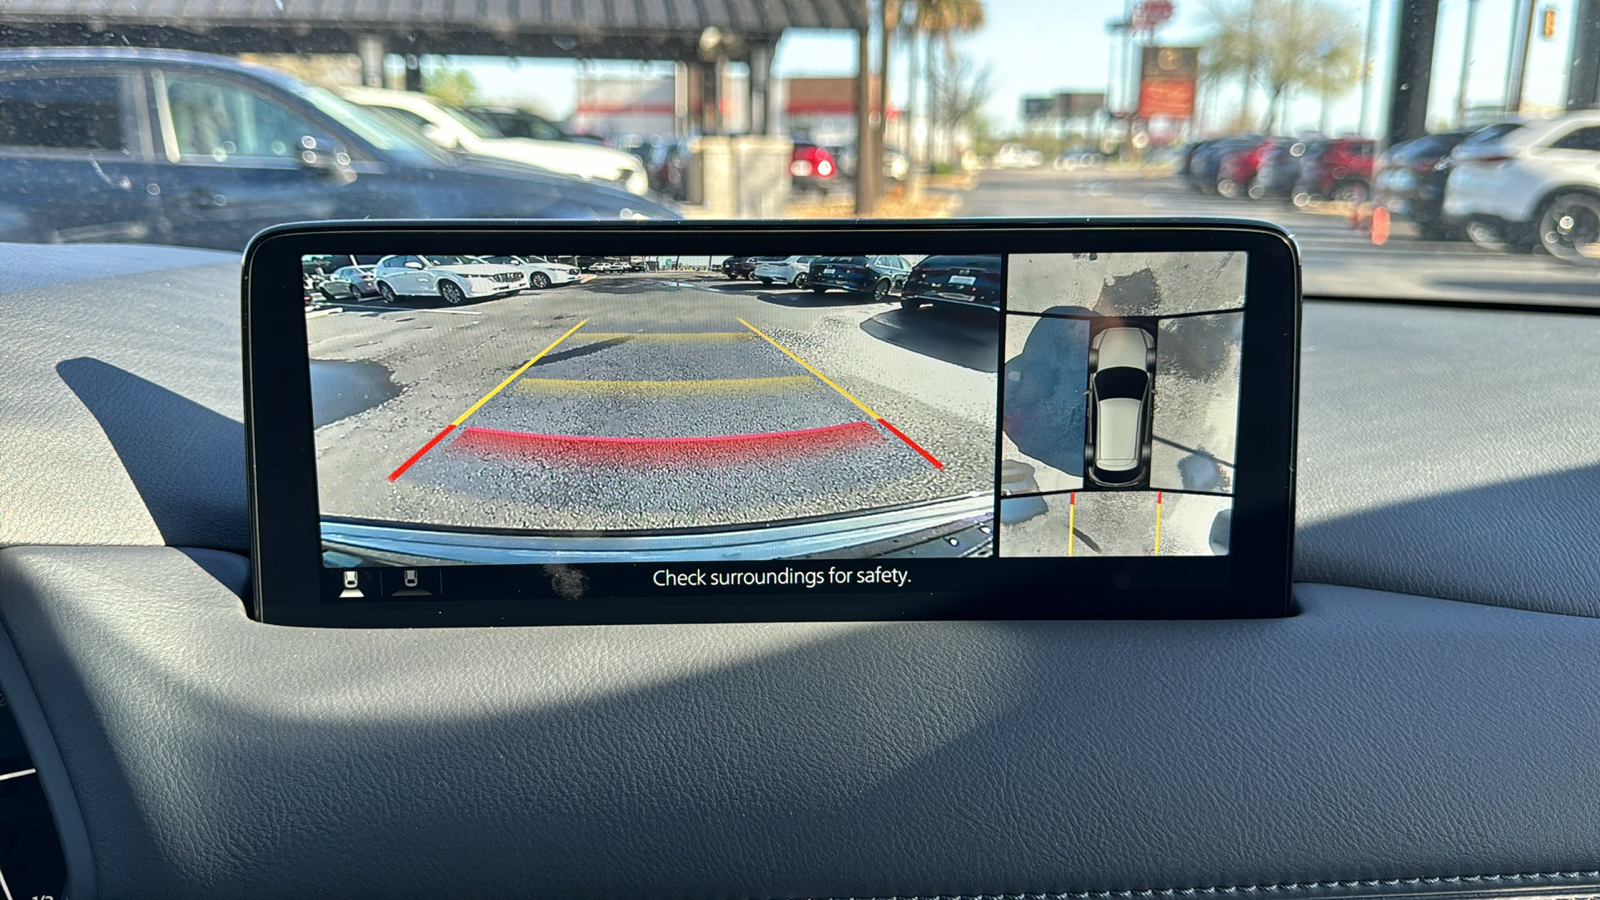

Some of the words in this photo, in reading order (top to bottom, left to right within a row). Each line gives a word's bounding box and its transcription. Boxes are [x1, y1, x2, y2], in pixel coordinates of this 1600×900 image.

[653, 569, 706, 587] Check
[711, 567, 824, 588] surroundings
[828, 566, 853, 584] for
[857, 566, 912, 588] safety.
